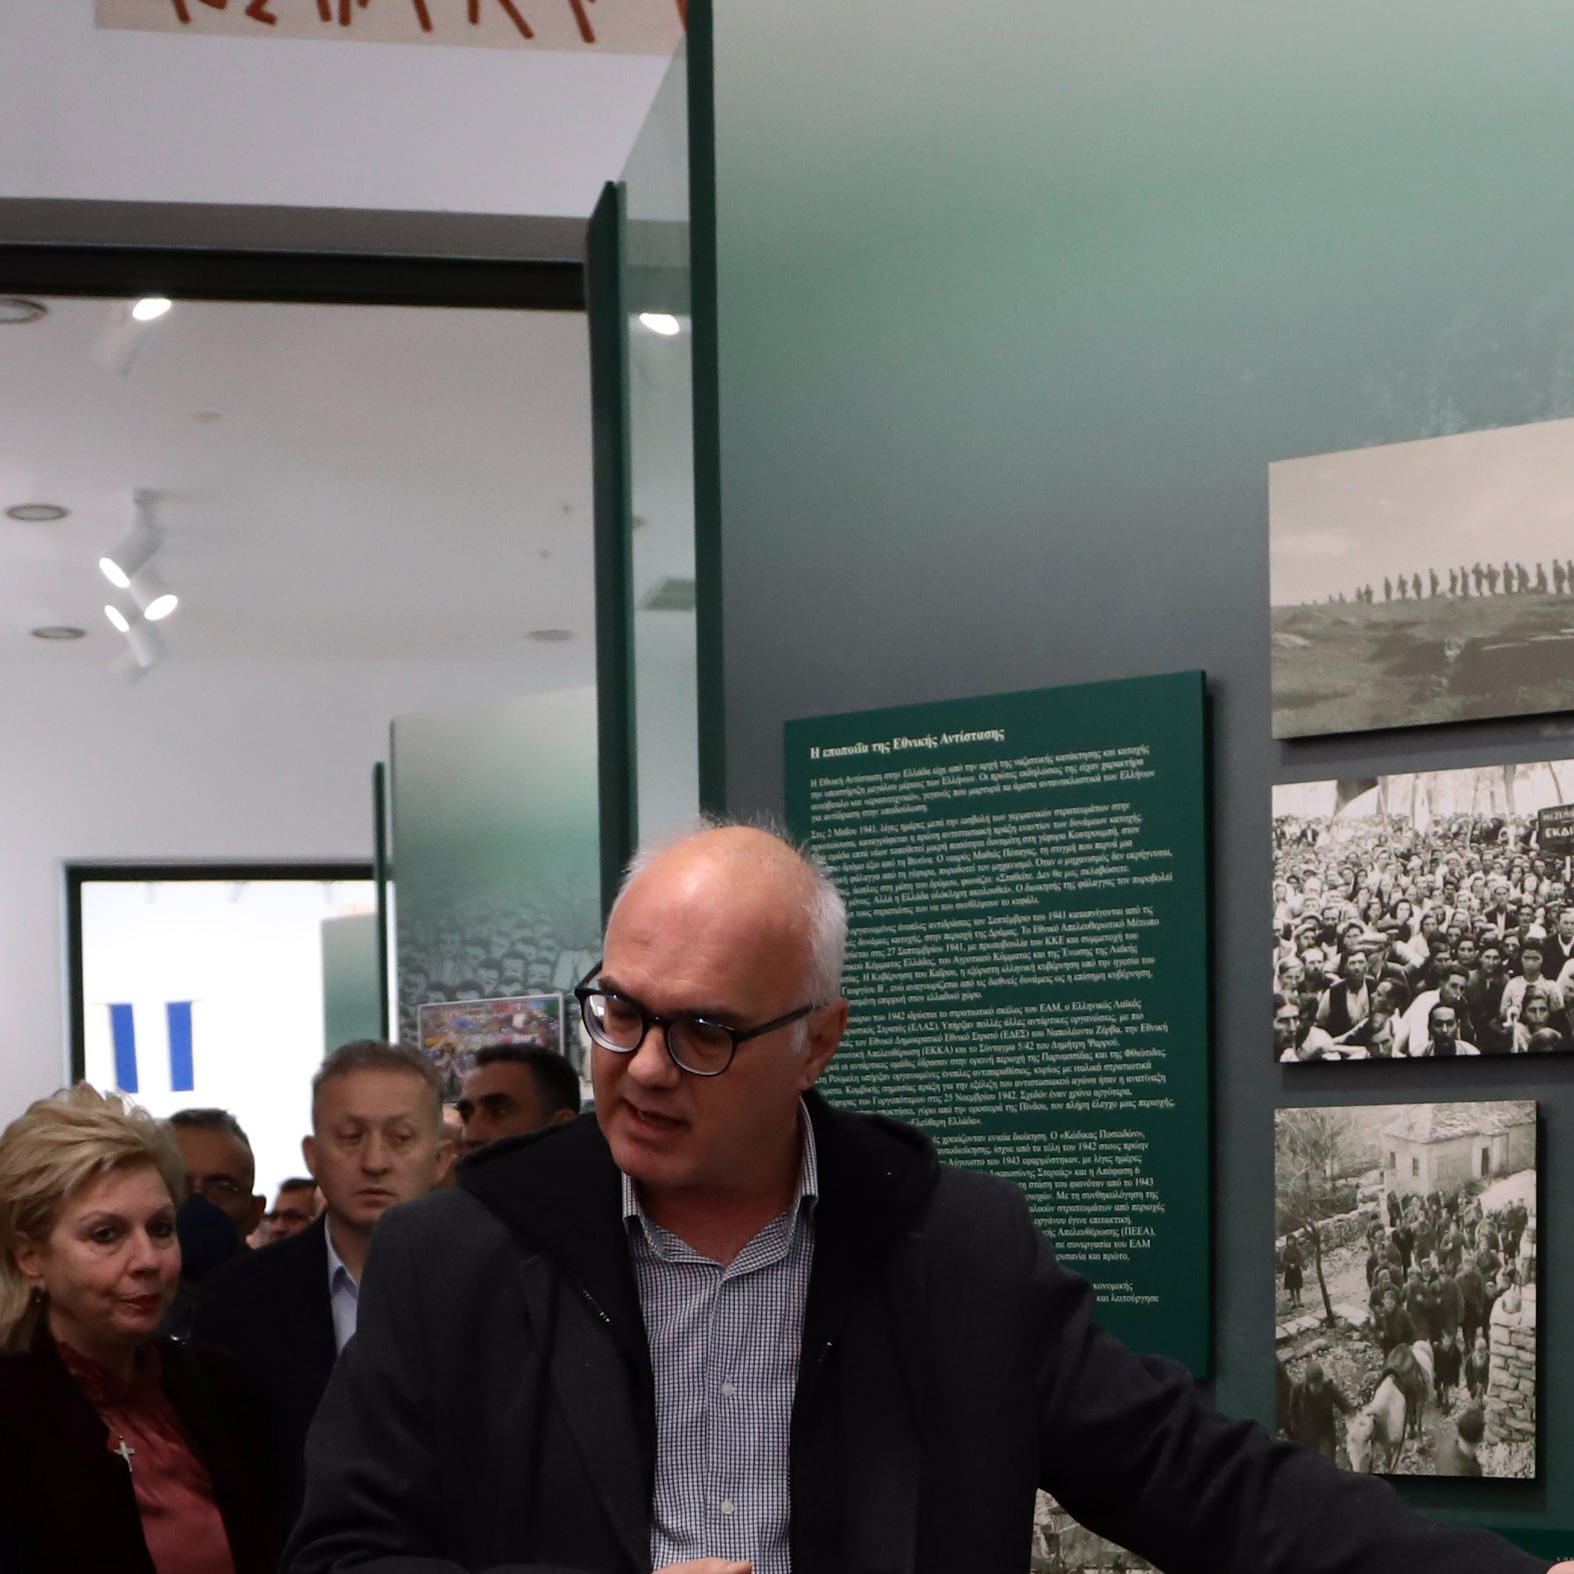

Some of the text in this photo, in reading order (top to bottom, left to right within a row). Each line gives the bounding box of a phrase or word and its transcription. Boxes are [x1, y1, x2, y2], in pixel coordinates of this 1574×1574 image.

[810, 726, 1004, 758] Η εποποιΐα της Εθνικής Αντίστασης
[1078, 1142, 1096, 1150] 1942
[1002, 1156, 1019, 1164] 1943
[1135, 1177, 1153, 1185] 1943
[1129, 1239, 1150, 1247] ΕΑΜ
